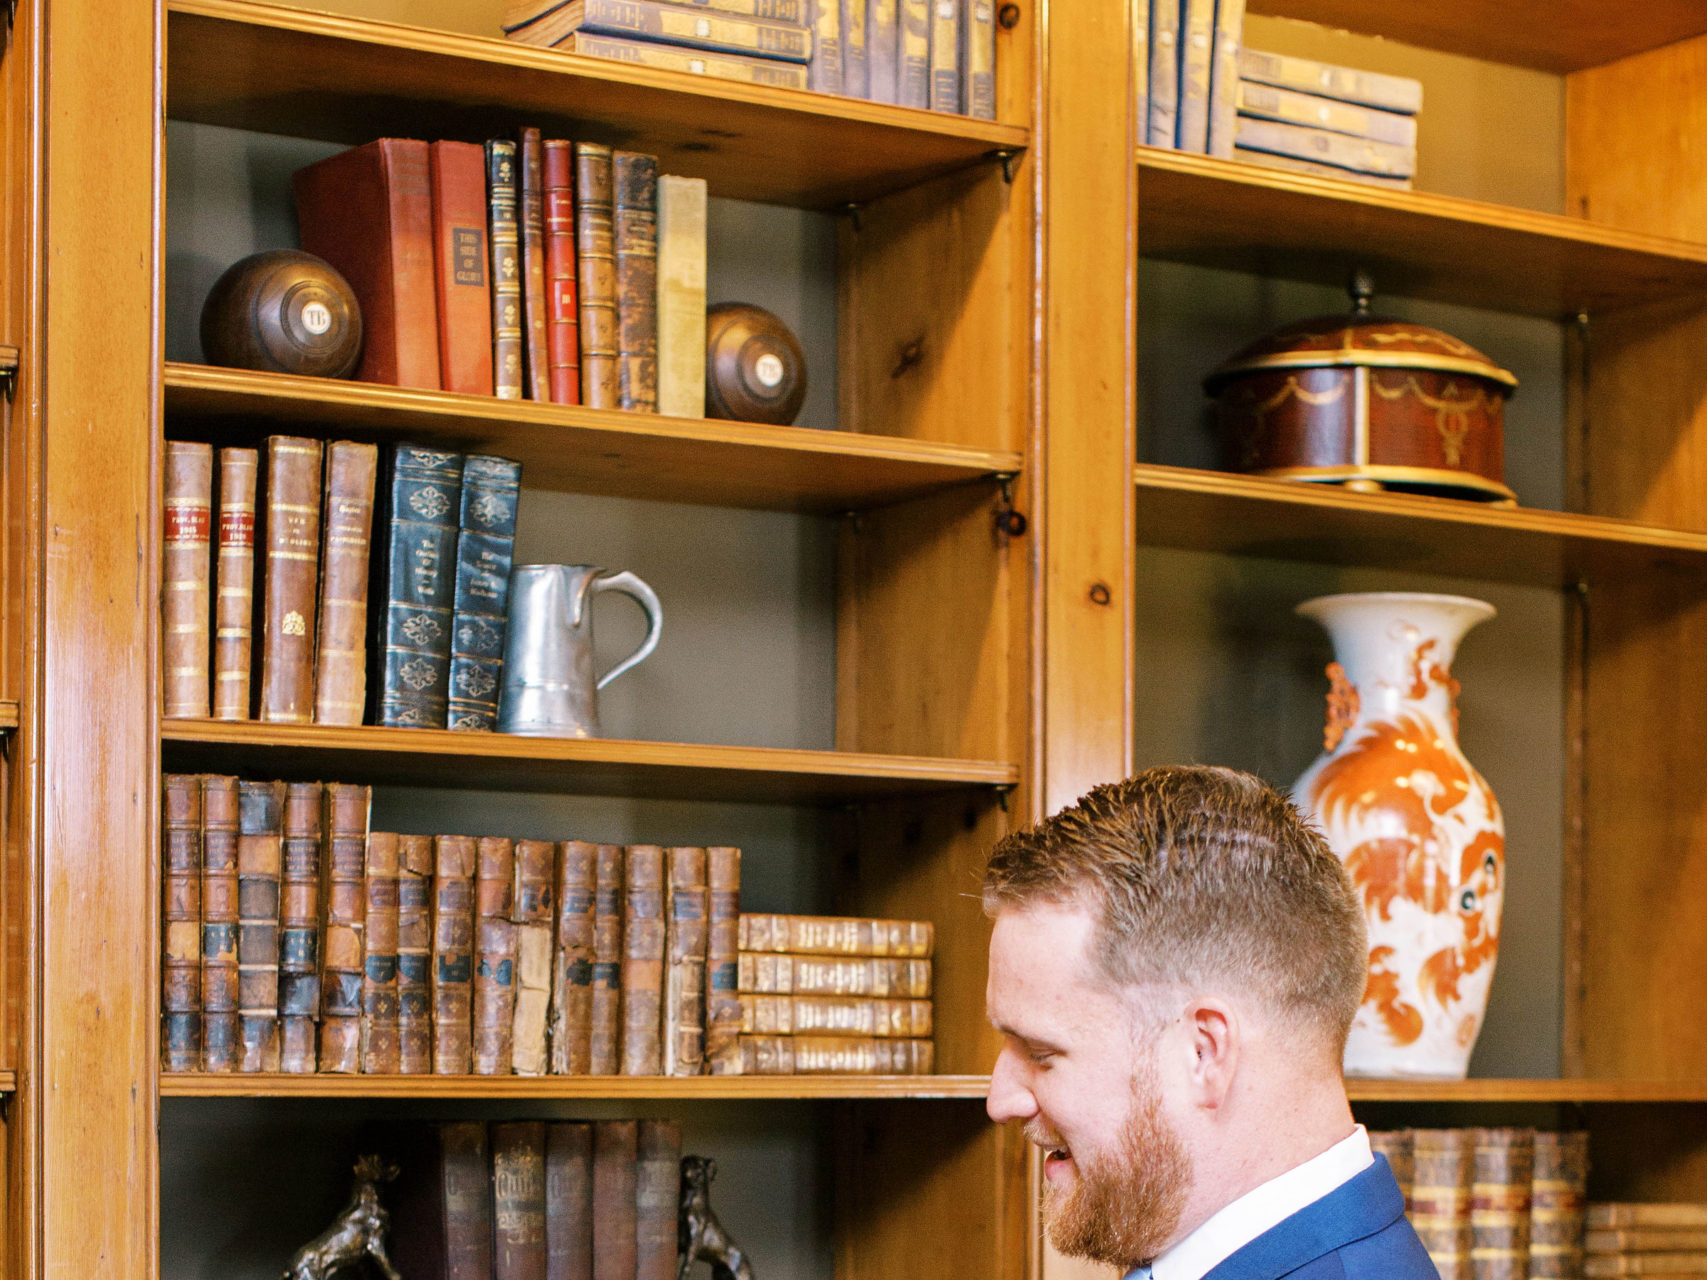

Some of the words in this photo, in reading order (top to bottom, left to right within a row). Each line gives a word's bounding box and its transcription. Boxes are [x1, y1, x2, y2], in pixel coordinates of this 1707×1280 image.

[460, 233, 477, 243] THIS
[460, 246, 477, 256] SIDE
[463, 258, 474, 268] OF
